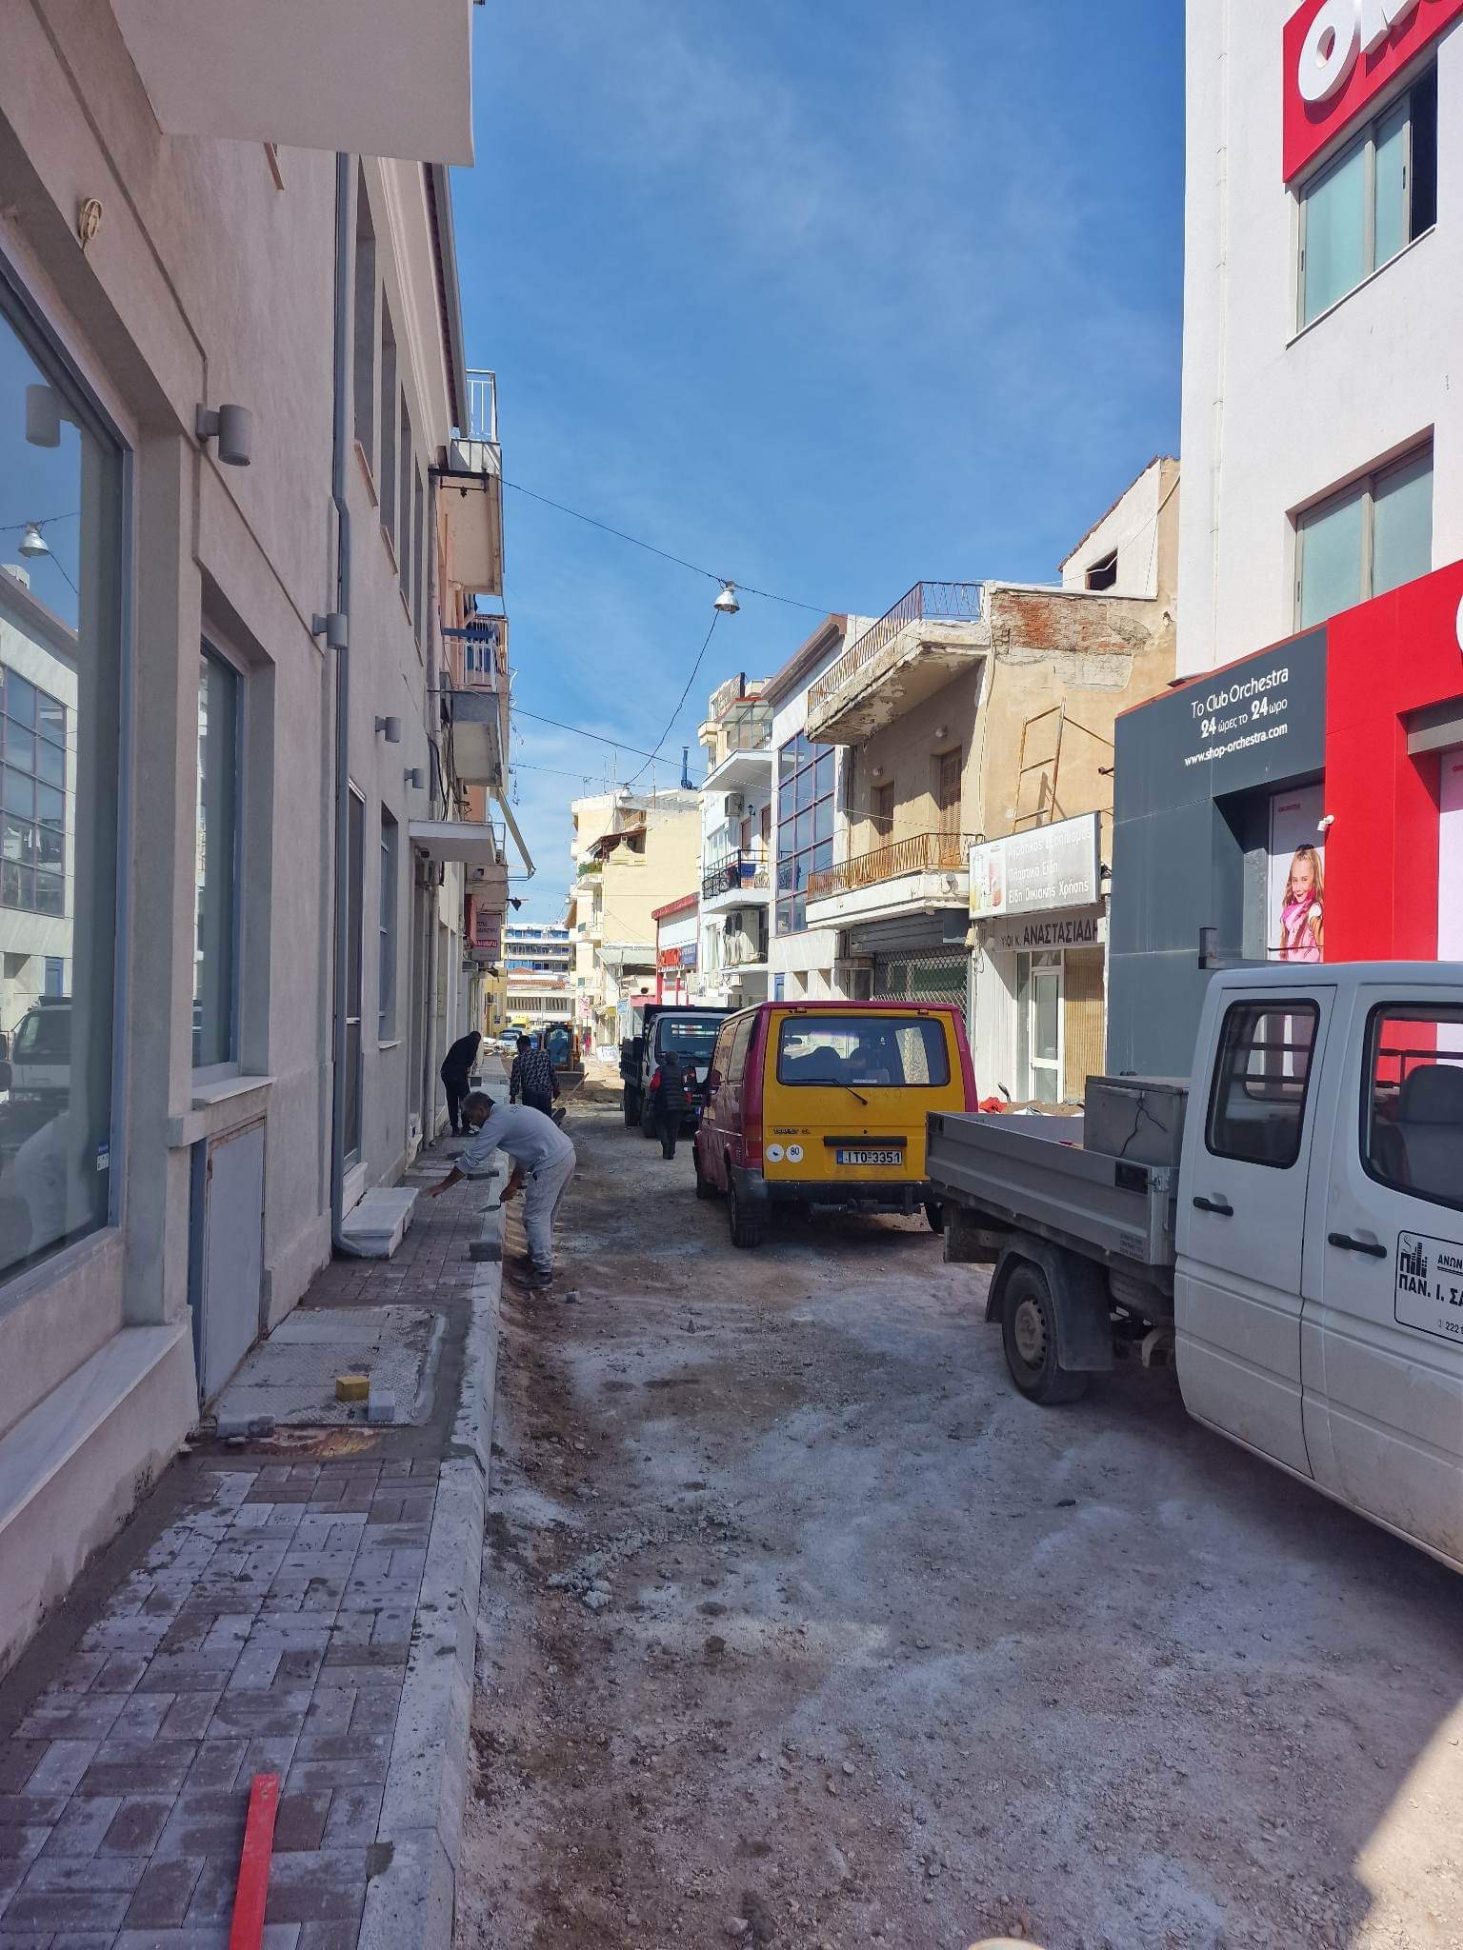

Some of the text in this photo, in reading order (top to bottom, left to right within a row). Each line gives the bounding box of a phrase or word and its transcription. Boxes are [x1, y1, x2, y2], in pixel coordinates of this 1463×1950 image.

[1206, 690, 1228, 712] Club
[1229, 667, 1289, 703] Orchestra
[1201, 717, 1217, 738] 24
[1184, 723, 1288, 767] www.shop-orchestra.com
[1399, 1273, 1431, 1297] ΠΑΝ.
